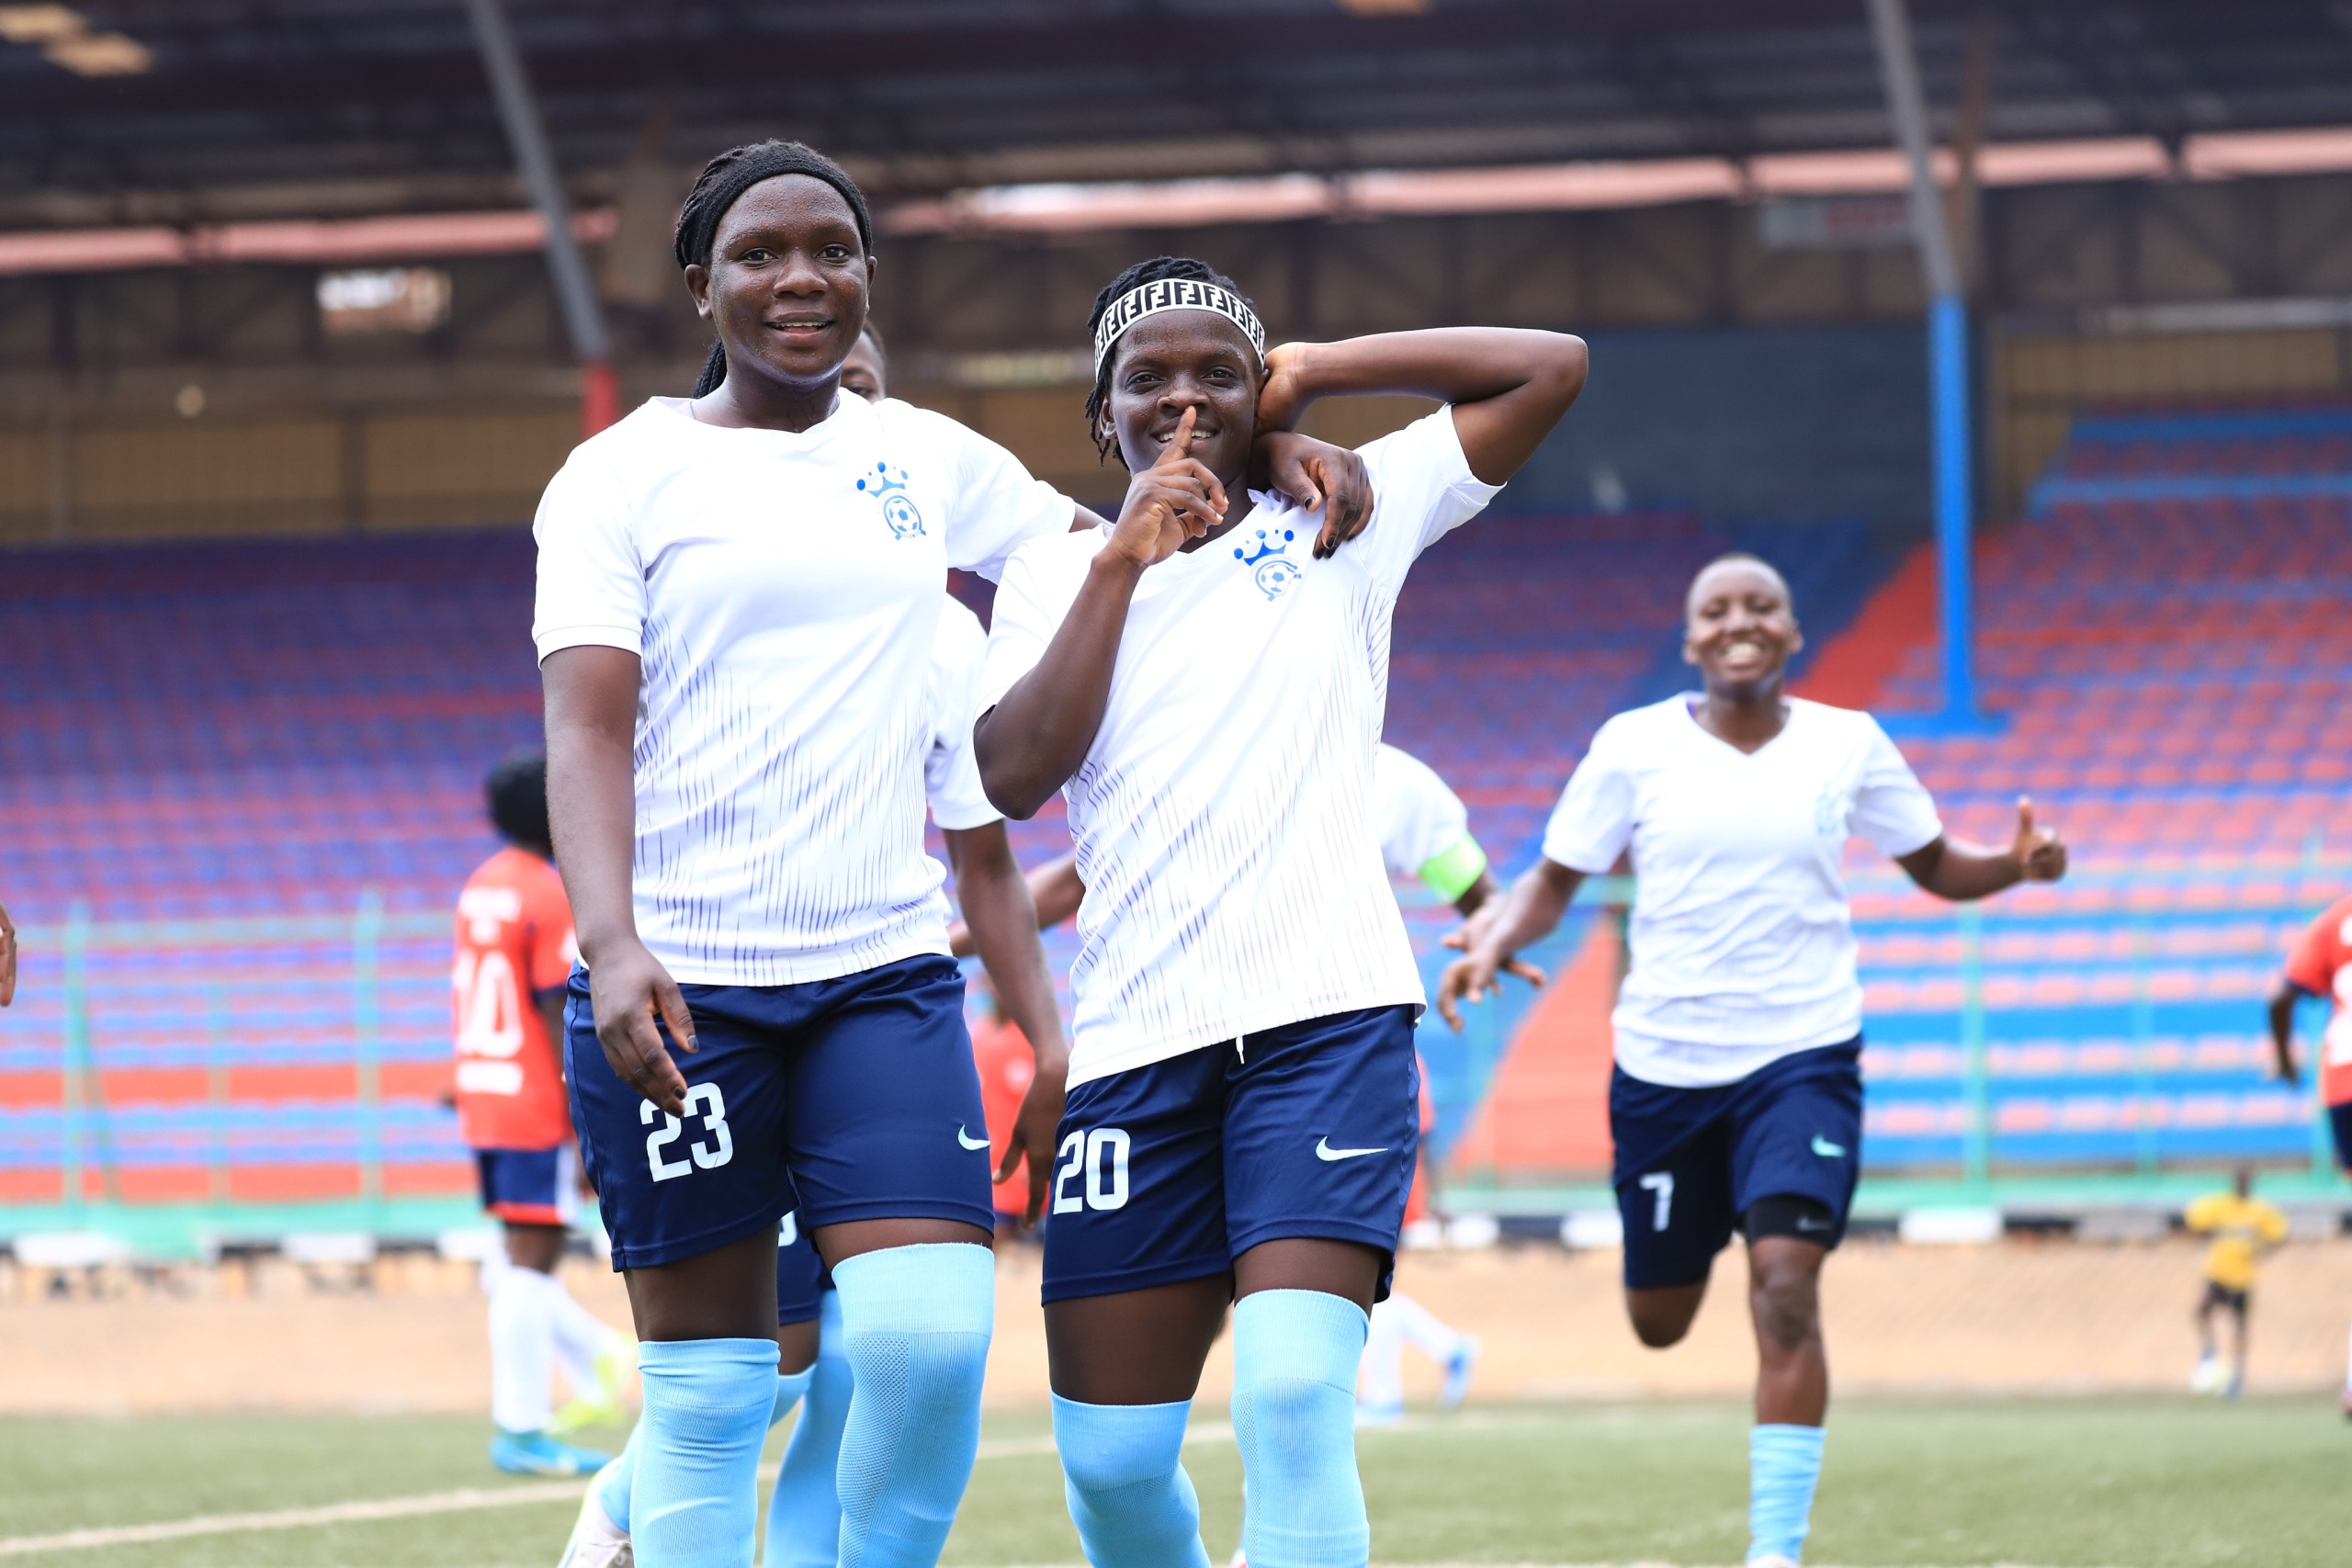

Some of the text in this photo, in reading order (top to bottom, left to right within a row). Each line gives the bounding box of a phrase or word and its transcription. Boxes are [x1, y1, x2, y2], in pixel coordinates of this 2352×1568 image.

[639, 1082, 733, 1182] 23
[1053, 1128, 1130, 1214] 20
[1640, 1171, 1674, 1232] 7
